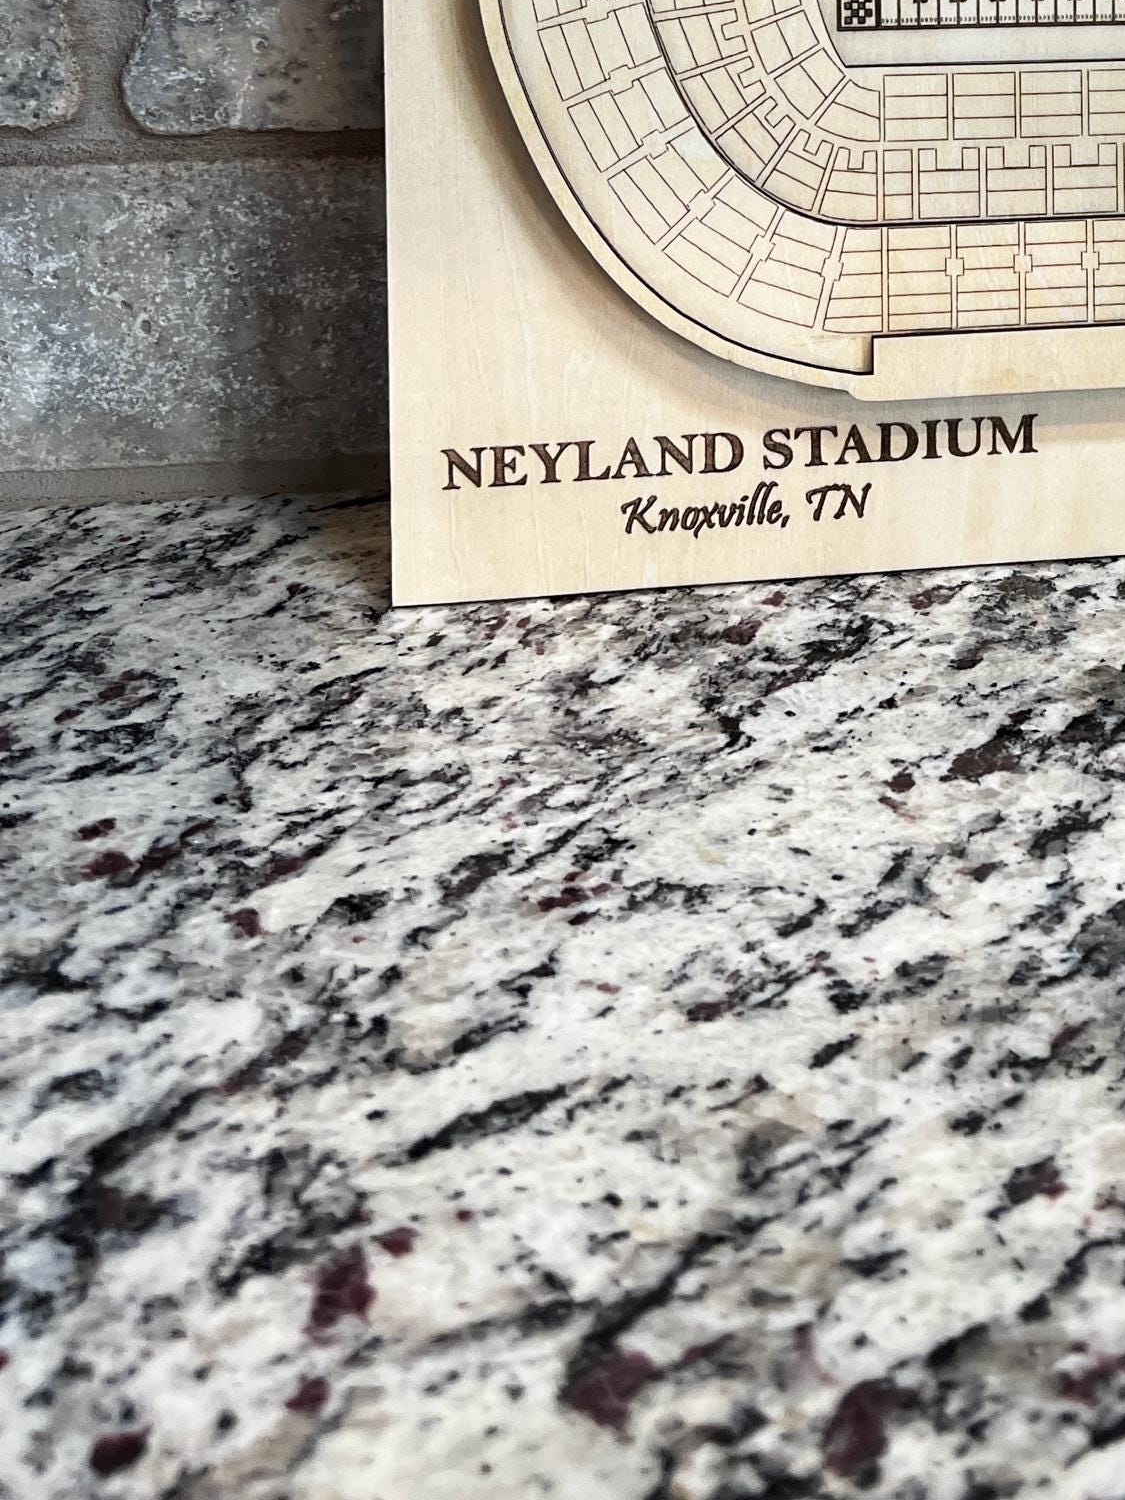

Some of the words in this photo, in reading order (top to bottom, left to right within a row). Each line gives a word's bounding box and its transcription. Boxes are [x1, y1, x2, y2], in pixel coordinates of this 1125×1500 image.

[441, 433, 744, 490] NEYLAND
[763, 414, 1038, 470] STADIUM
[621, 481, 790, 539] Knoxville,
[806, 483, 872, 521] TN
